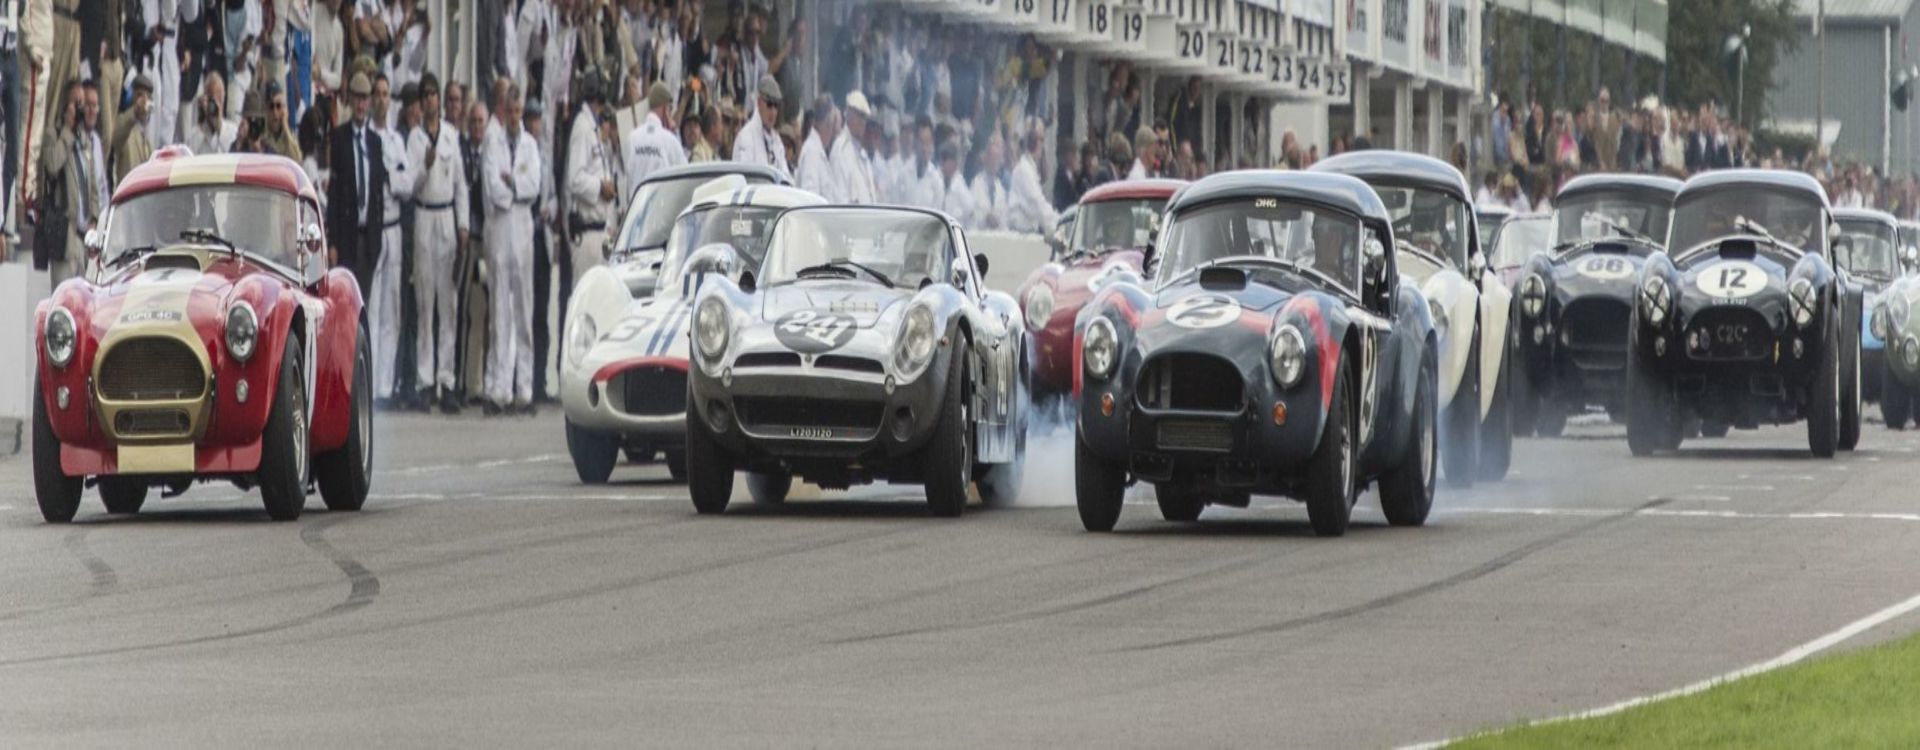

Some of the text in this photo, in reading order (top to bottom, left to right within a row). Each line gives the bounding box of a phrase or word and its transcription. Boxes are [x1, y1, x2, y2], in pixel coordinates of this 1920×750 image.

[1052, 0, 1069, 23] 17
[1089, 4, 1107, 34] 18
[1124, 13, 1142, 42] 19
[1180, 31, 1203, 57] 20
[1218, 39, 1234, 66] 21
[1242, 47, 1263, 74] 22
[1272, 56, 1292, 82] 23
[1300, 64, 1319, 89] 24
[1327, 71, 1346, 96] 25
[1586, 259, 1624, 272] 66
[1719, 268, 1747, 289] 12
[1174, 295, 1231, 320] 2
[780, 311, 852, 347] 241
